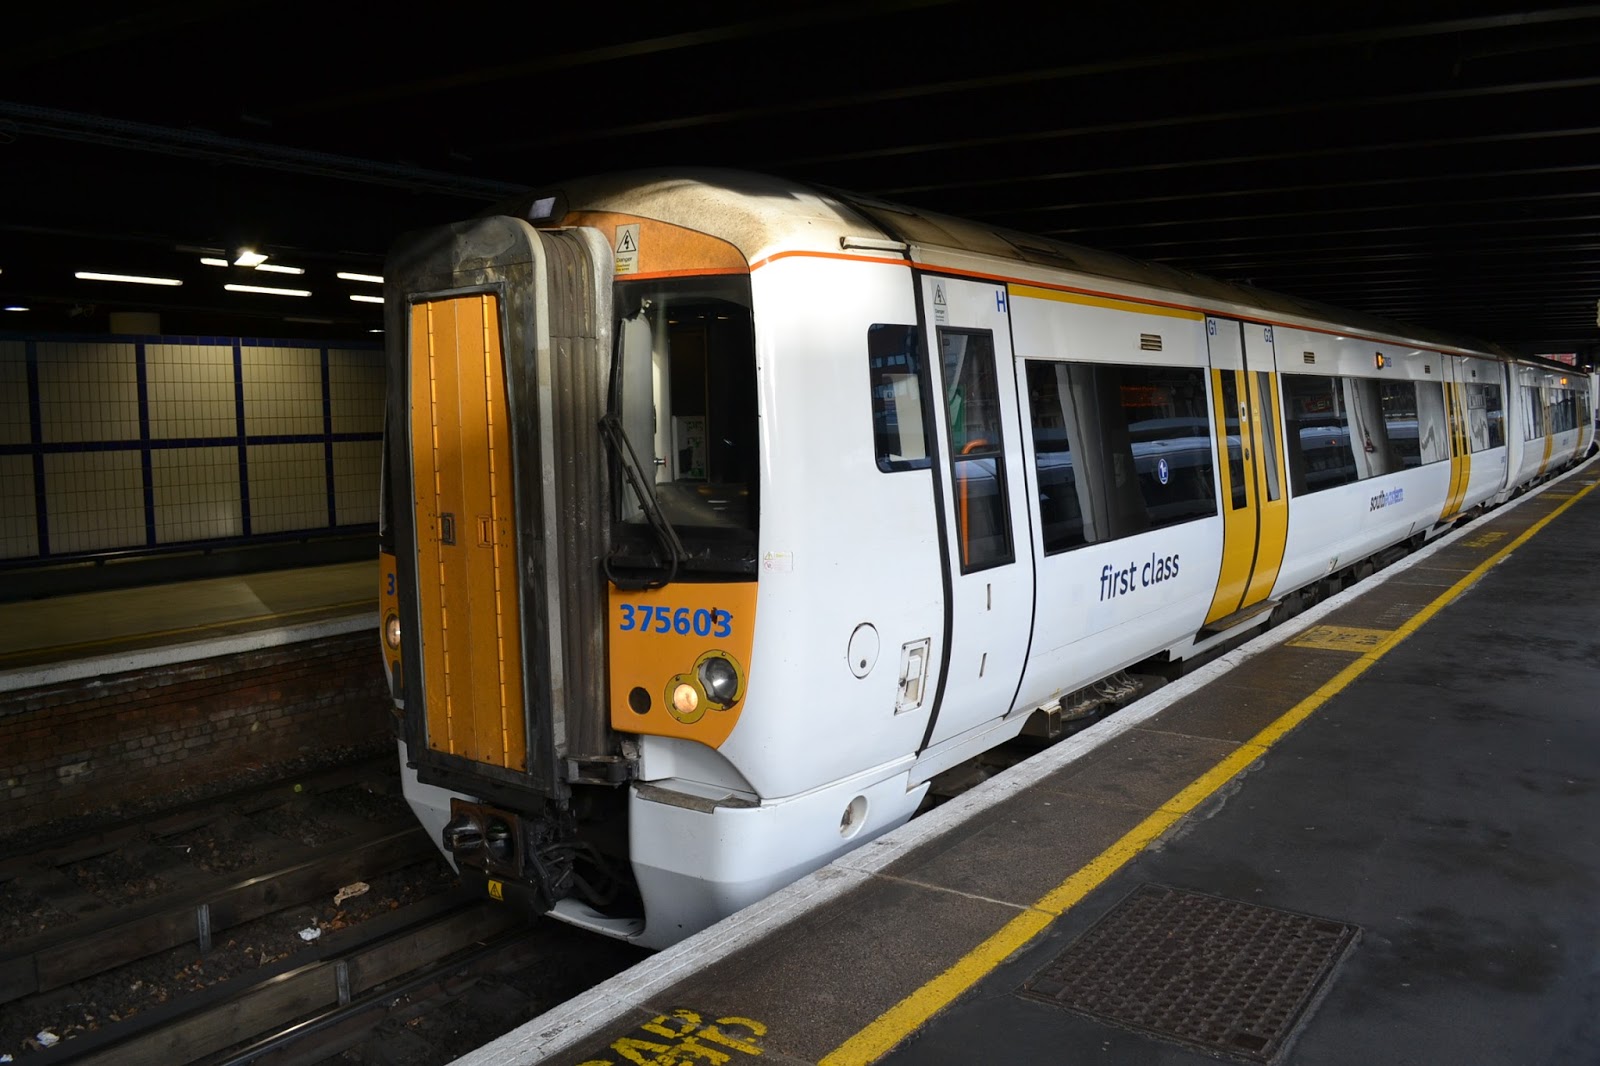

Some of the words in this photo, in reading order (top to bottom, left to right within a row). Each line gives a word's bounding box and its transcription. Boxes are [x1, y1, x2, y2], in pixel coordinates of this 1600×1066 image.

[995, 290, 1007, 313] H
[1208, 320, 1217, 336] G1
[1263, 328, 1273, 343] G2
[1100, 561, 1137, 602] first
[1141, 552, 1179, 588] class
[619, 603, 732, 638] 375603
